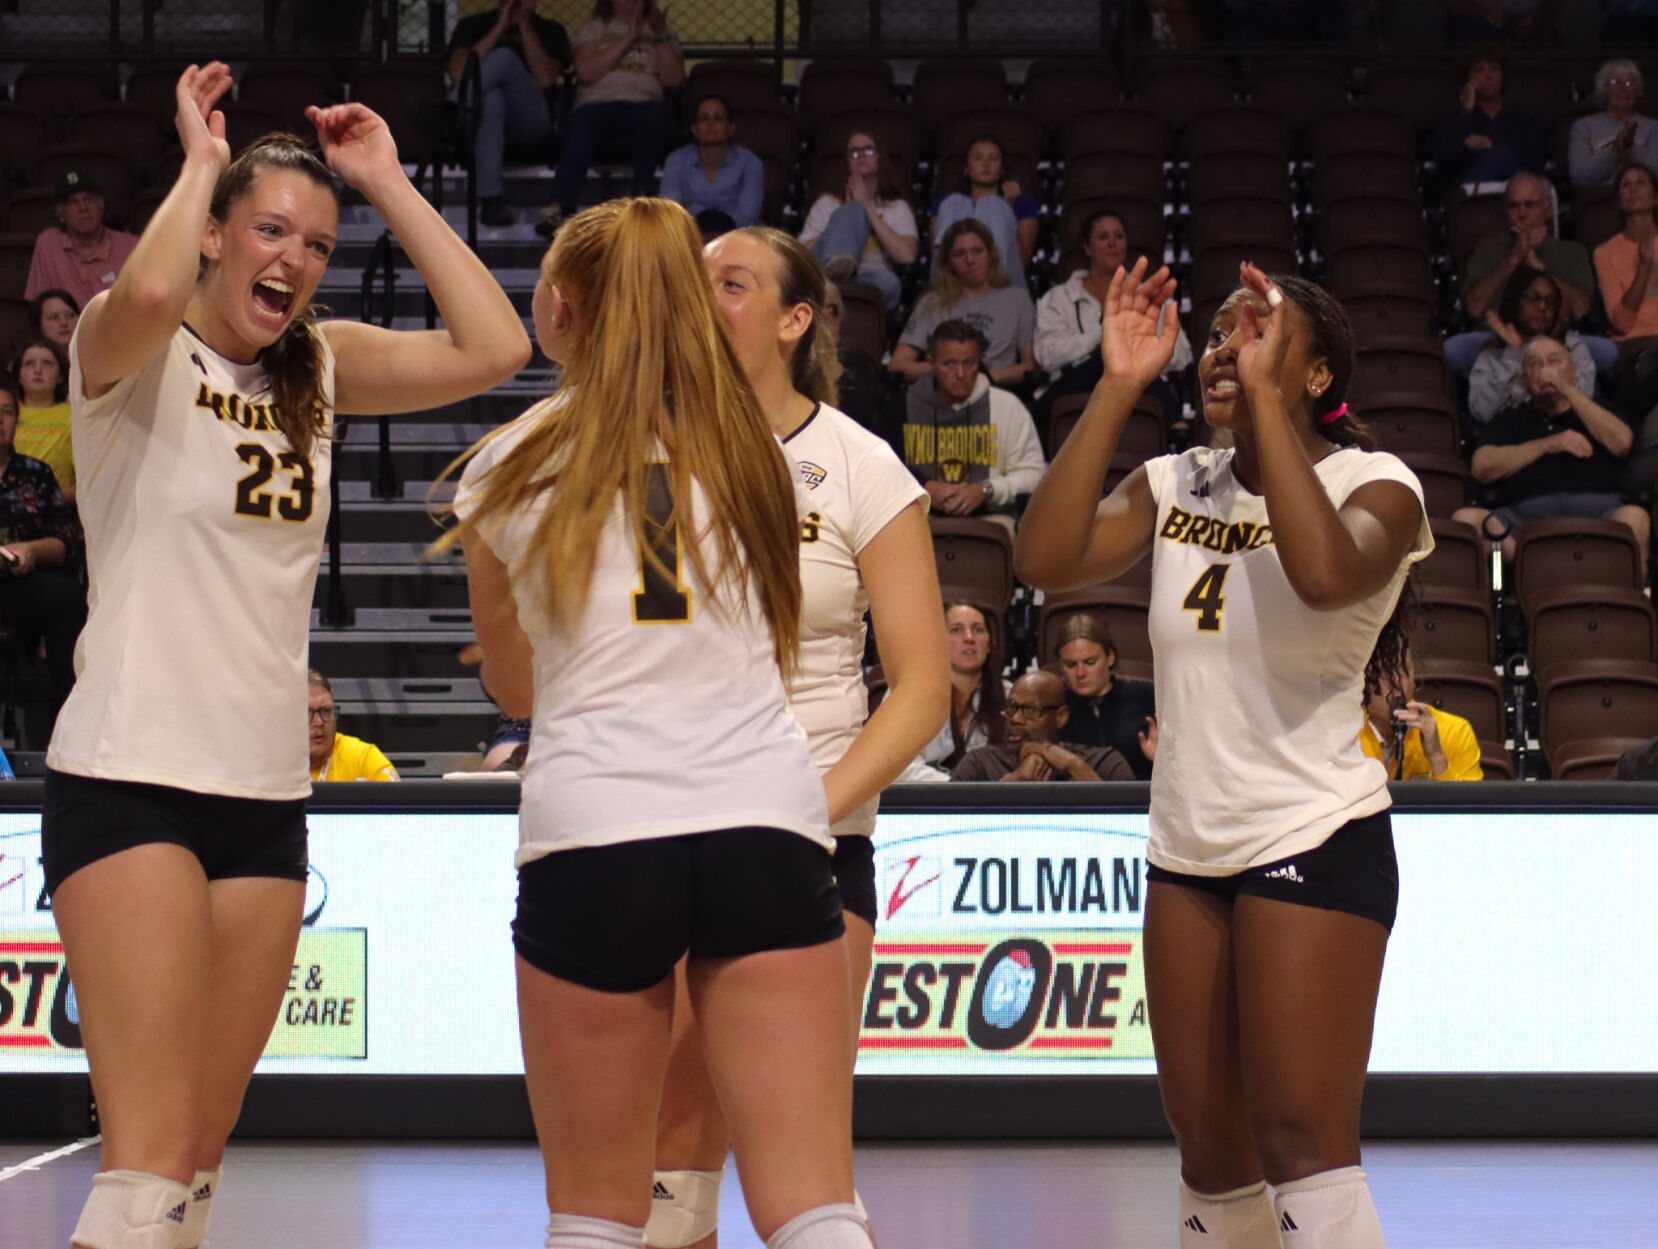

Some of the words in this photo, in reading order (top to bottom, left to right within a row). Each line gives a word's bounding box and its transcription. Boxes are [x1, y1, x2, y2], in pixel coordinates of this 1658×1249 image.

[903, 424, 935, 464] WMU
[938, 425, 997, 467] BRONCOS
[943, 463, 962, 482] W
[233, 441, 316, 524] 23
[630, 459, 692, 625] 1
[1159, 504, 1274, 555] BRONC
[1182, 562, 1231, 632] 4
[952, 857, 1149, 915] ZOLMAN
[305, 964, 323, 991] &
[864, 937, 1128, 1051] ESTONE
[285, 997, 355, 1026] CARE
